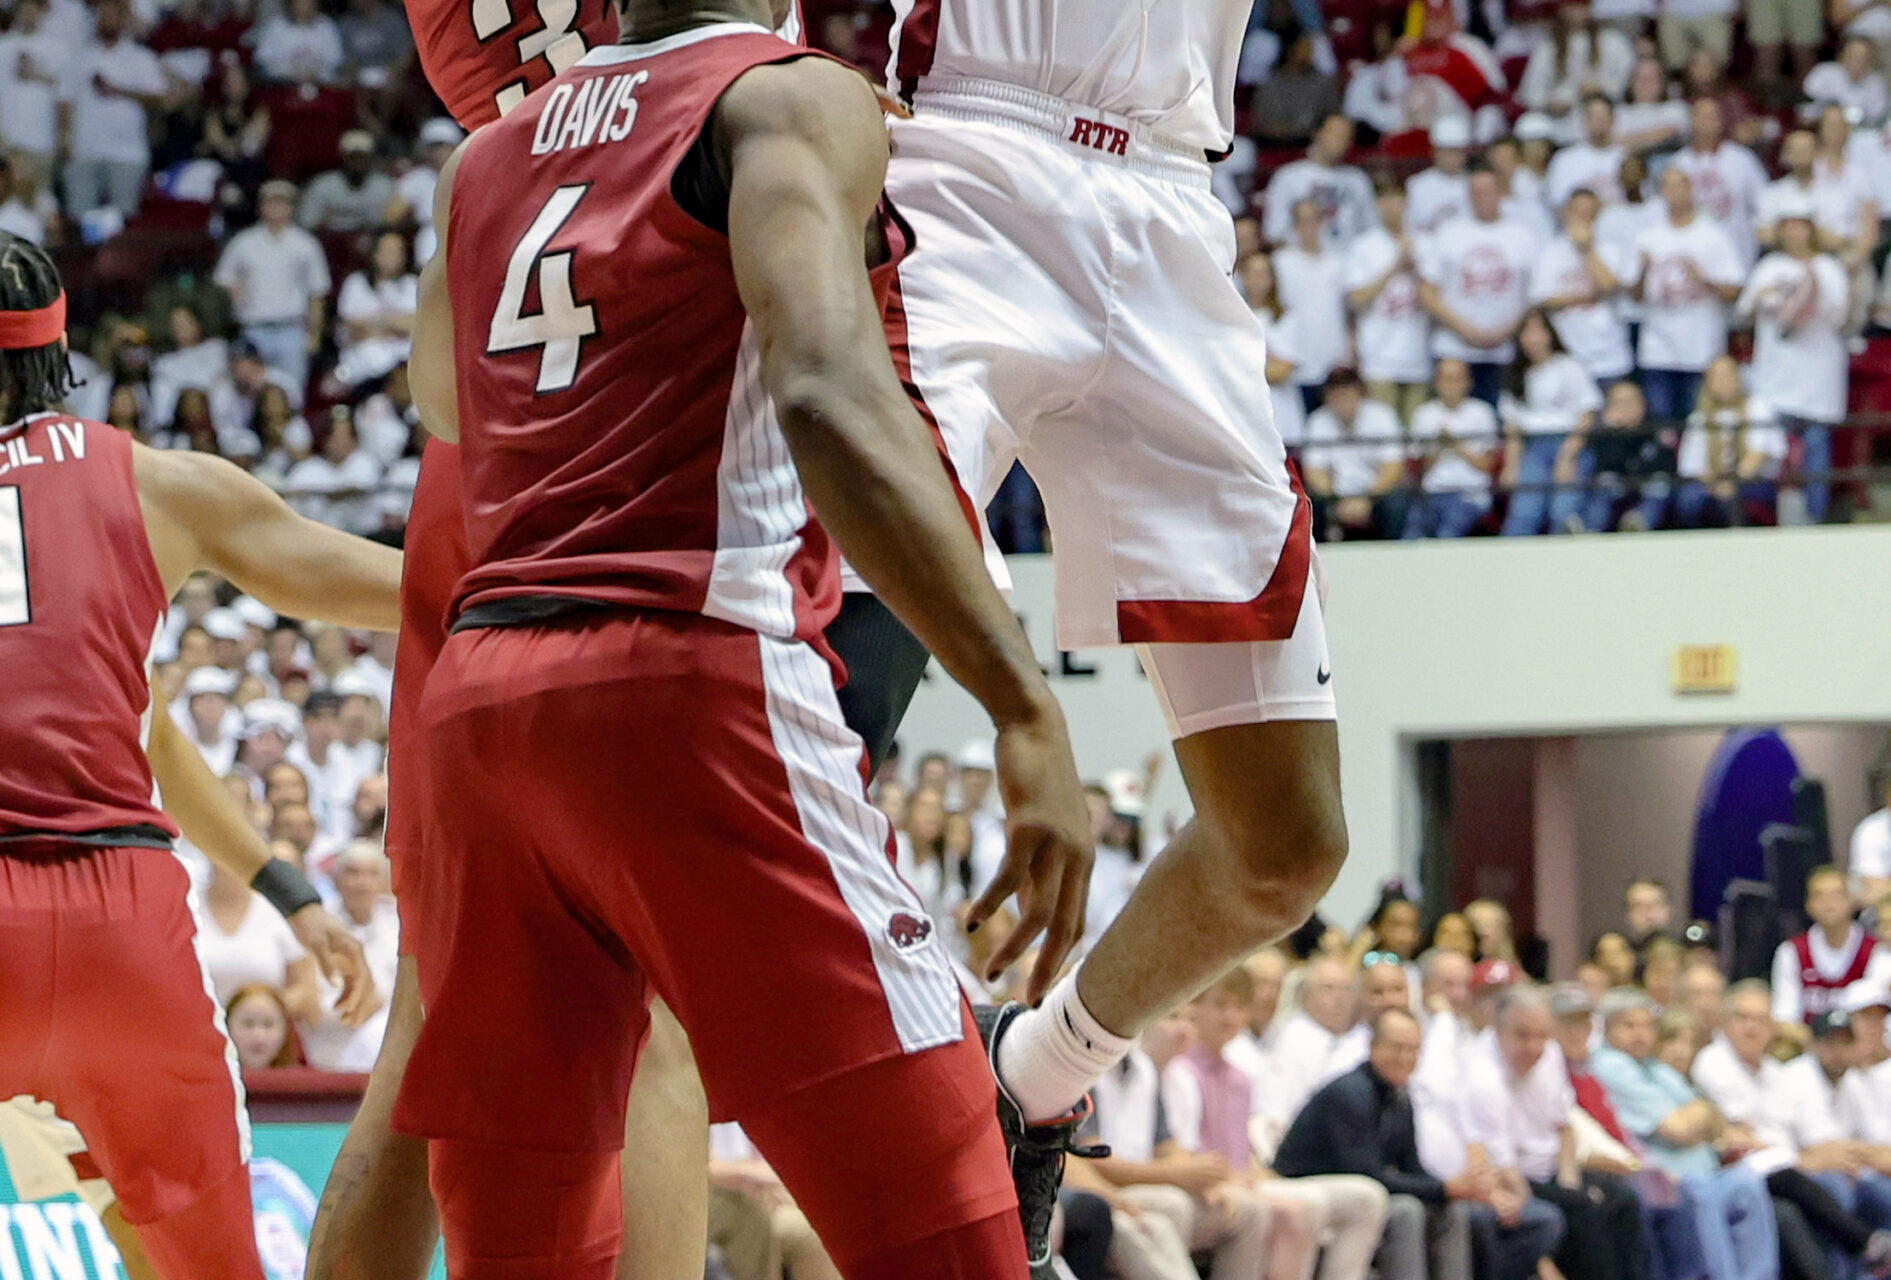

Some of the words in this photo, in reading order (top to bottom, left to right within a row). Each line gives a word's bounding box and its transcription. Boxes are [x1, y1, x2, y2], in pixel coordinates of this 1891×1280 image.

[531, 70, 649, 156] DAVIS
[1069, 117, 1130, 156] RTR
[486, 183, 598, 395] 4
[47, 422, 86, 462] IV
